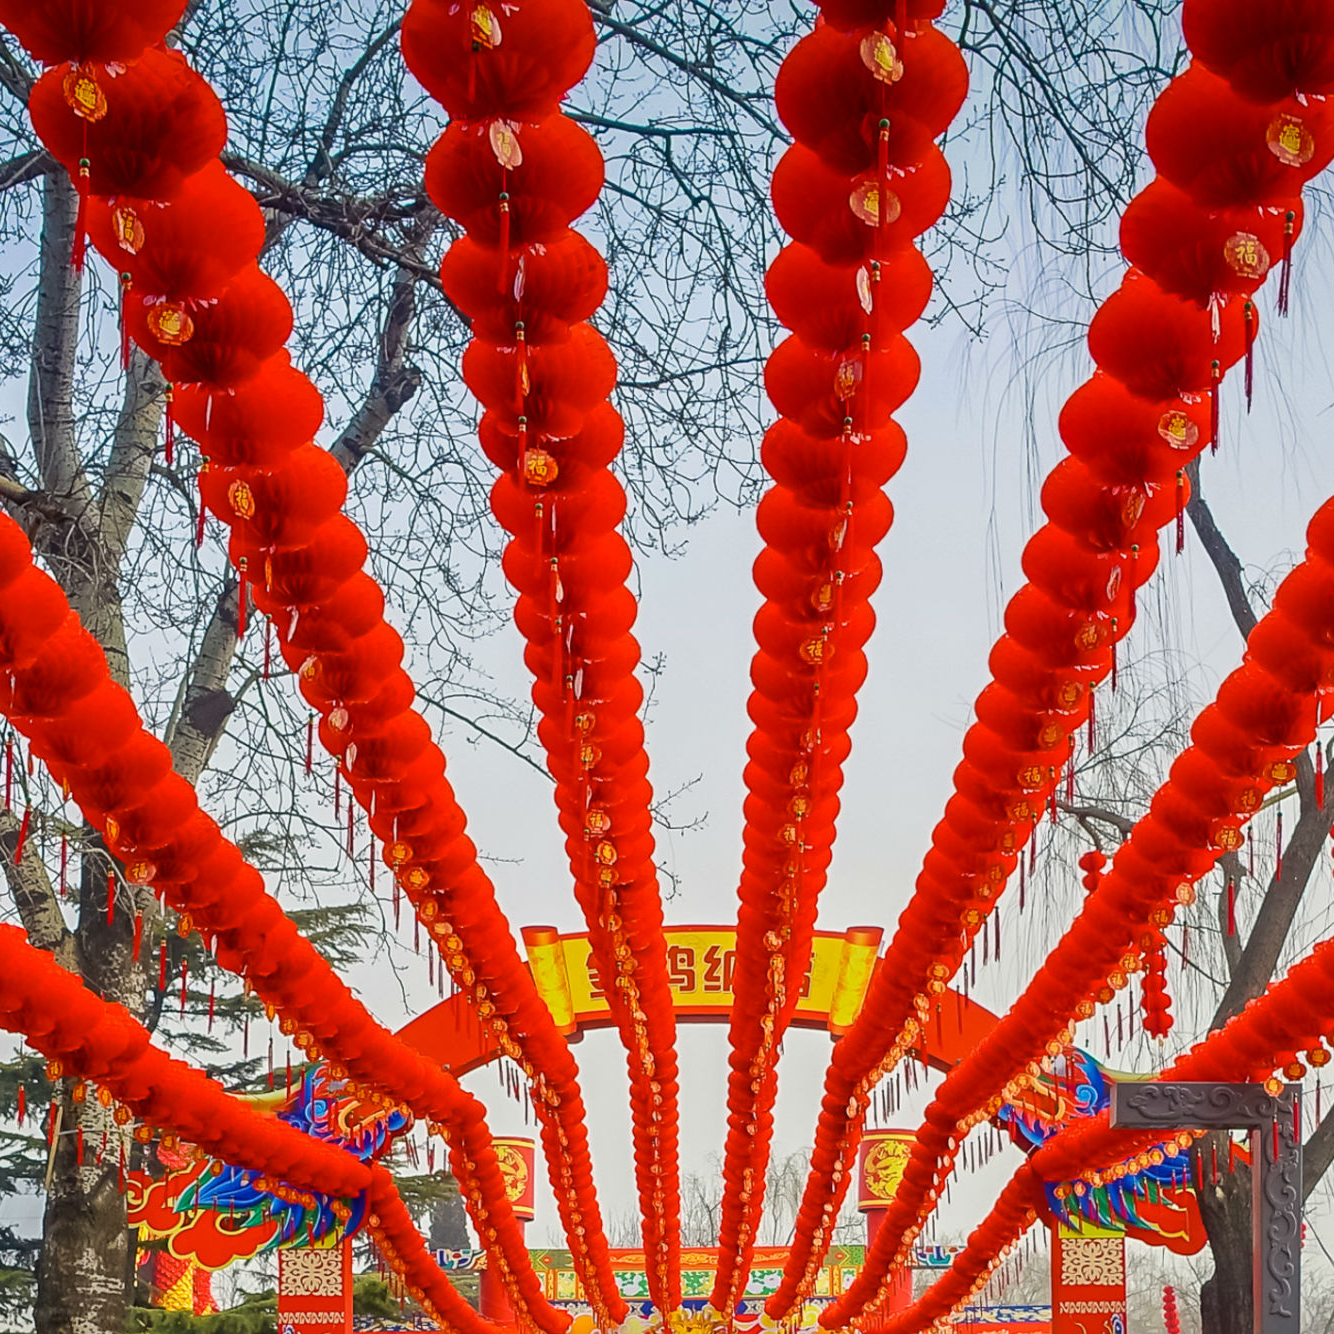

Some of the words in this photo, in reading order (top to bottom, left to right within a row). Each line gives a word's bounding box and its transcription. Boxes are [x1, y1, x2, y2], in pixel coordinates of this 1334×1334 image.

[1235, 241, 1257, 267] 福
[528, 455, 548, 477] 福
[807, 640, 823, 659] 福
